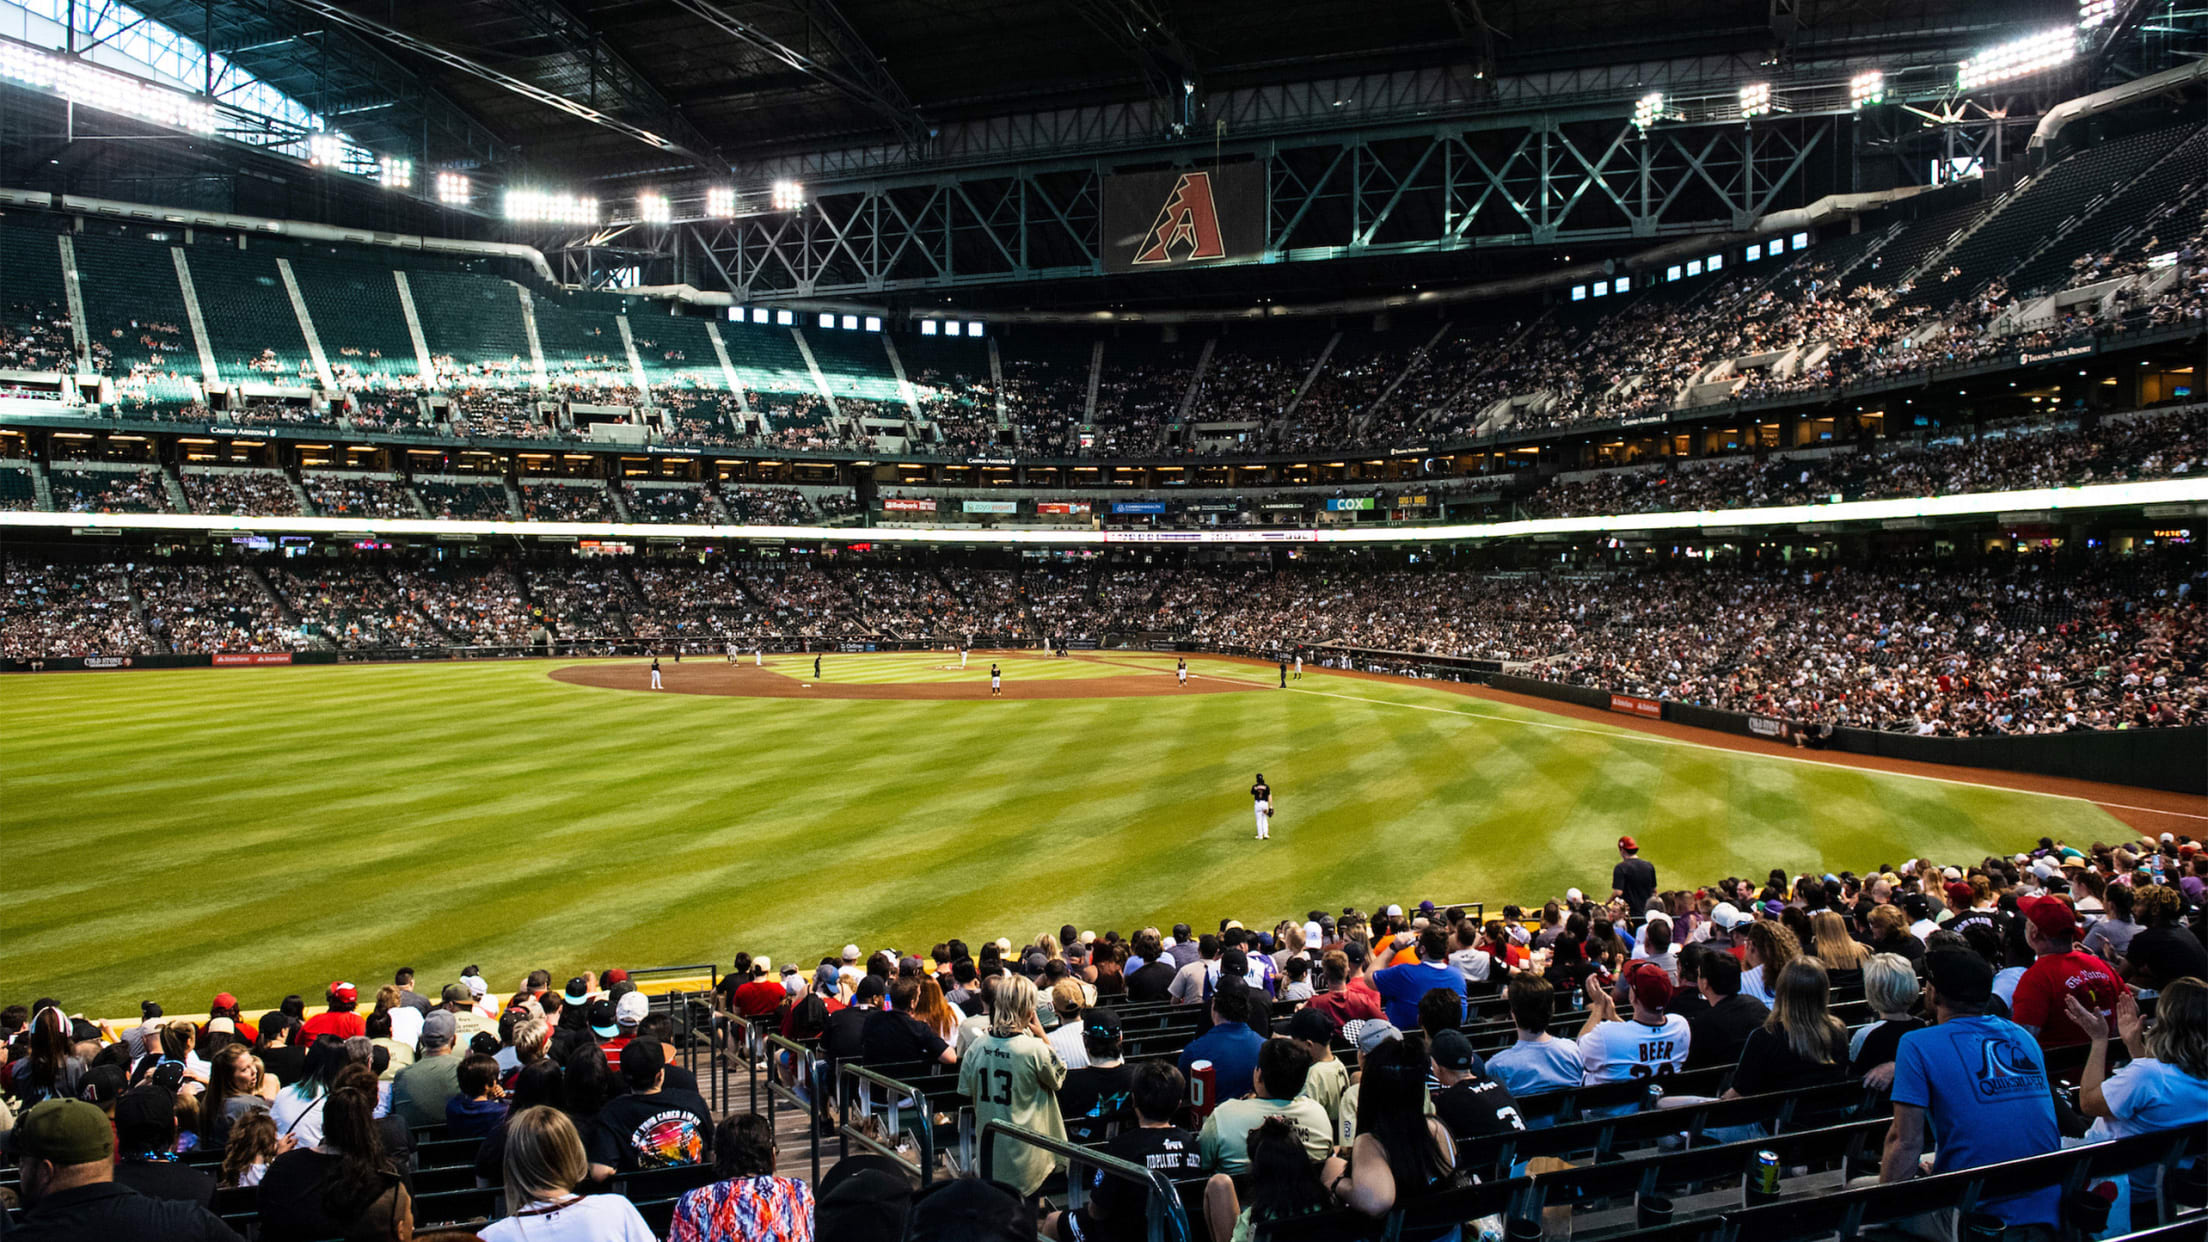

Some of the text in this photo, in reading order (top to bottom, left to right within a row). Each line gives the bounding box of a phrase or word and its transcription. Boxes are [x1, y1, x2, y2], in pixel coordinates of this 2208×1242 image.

[1336, 498, 1364, 510] COX
[1639, 1040, 1674, 1062] BEER
[979, 1067, 1012, 1106] 13
[657, 1110, 681, 1121] CARES
[681, 1110, 701, 1126] AWAY
